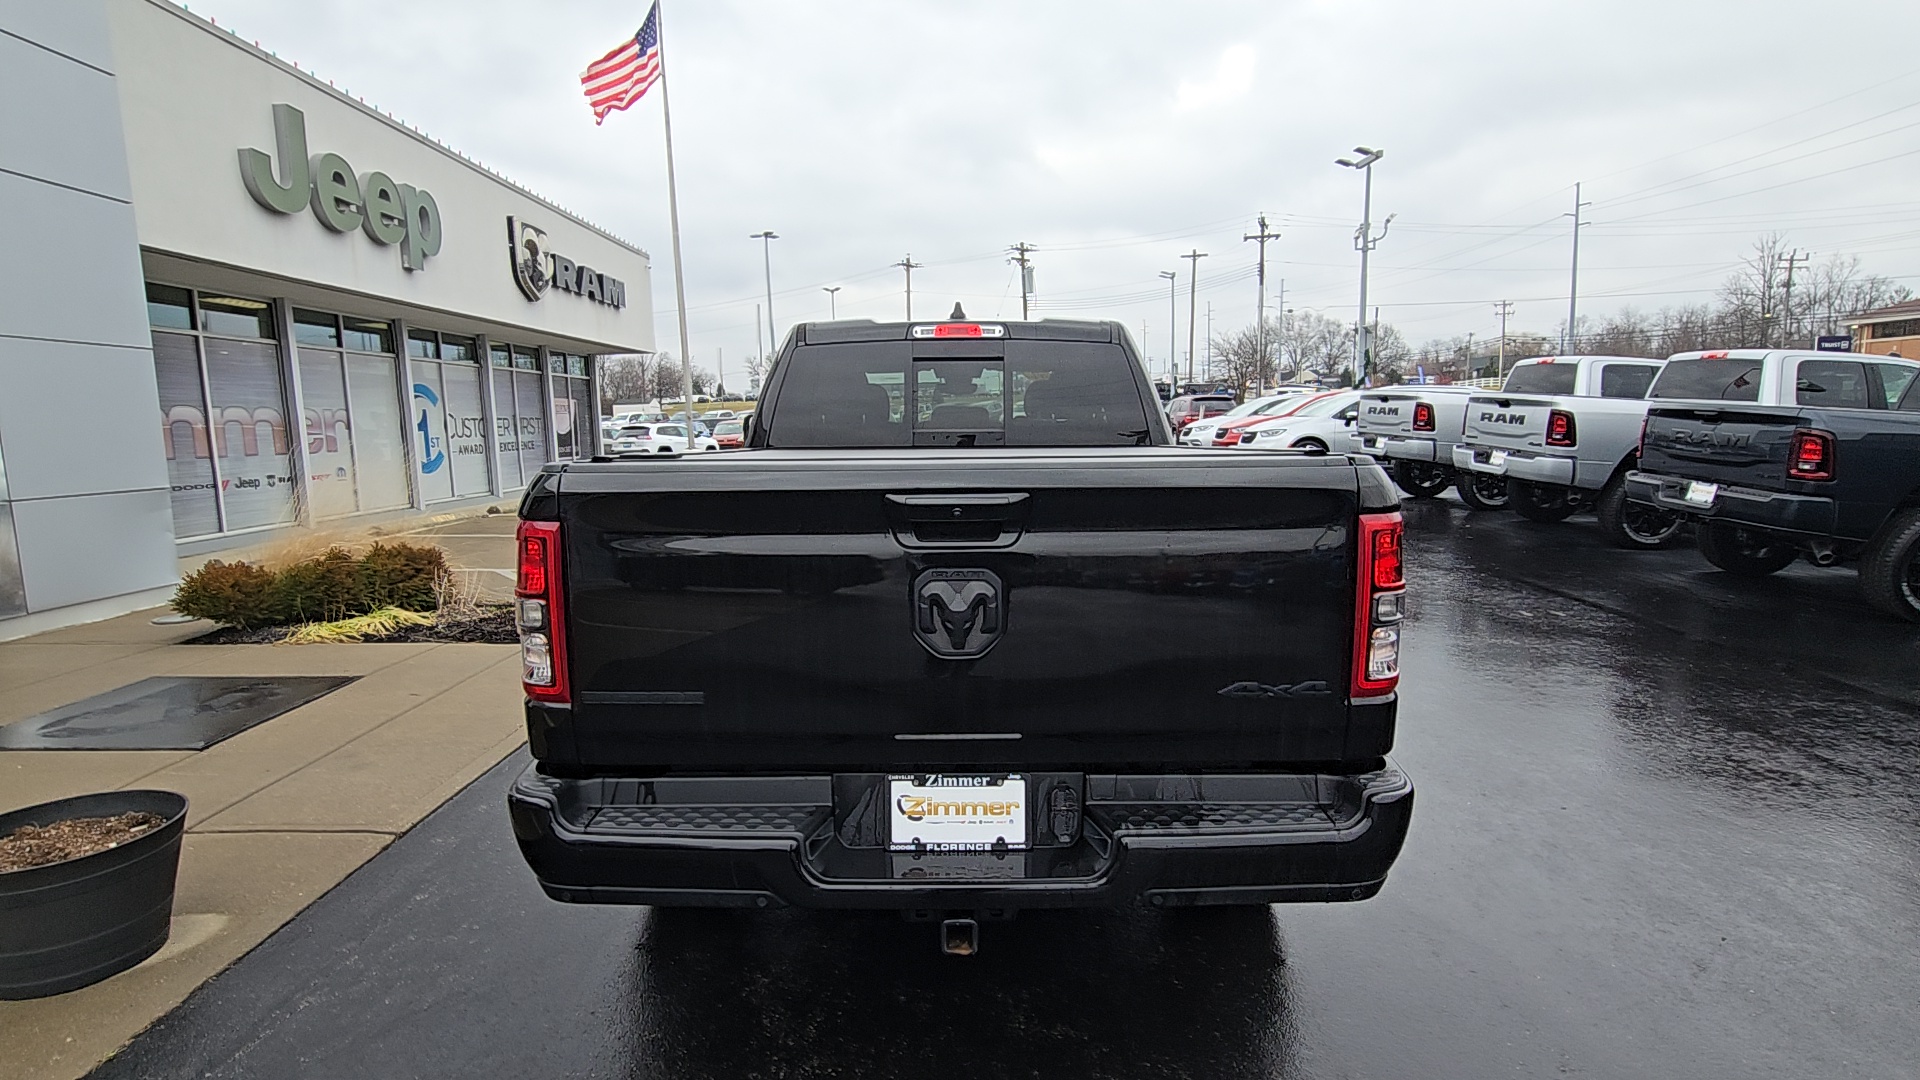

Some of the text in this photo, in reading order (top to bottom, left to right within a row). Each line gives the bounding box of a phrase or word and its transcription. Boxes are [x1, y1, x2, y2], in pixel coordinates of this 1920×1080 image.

[238, 103, 442, 271] Jeep
[550, 253, 626, 309] RAM
[1367, 406, 1399, 416] RAM
[444, 413, 511, 439] CUSTOER
[1480, 412, 1526, 426] RAM
[1671, 428, 1751, 449] RAM
[458, 440, 535, 455] AWARD EXCELENCE
[172, 483, 216, 491] DODG
[234, 477, 260, 490] Jeep
[925, 774, 990, 787] Zimmer
[903, 796, 1020, 816] Zimmer
[926, 843, 992, 851] FLORENCE
